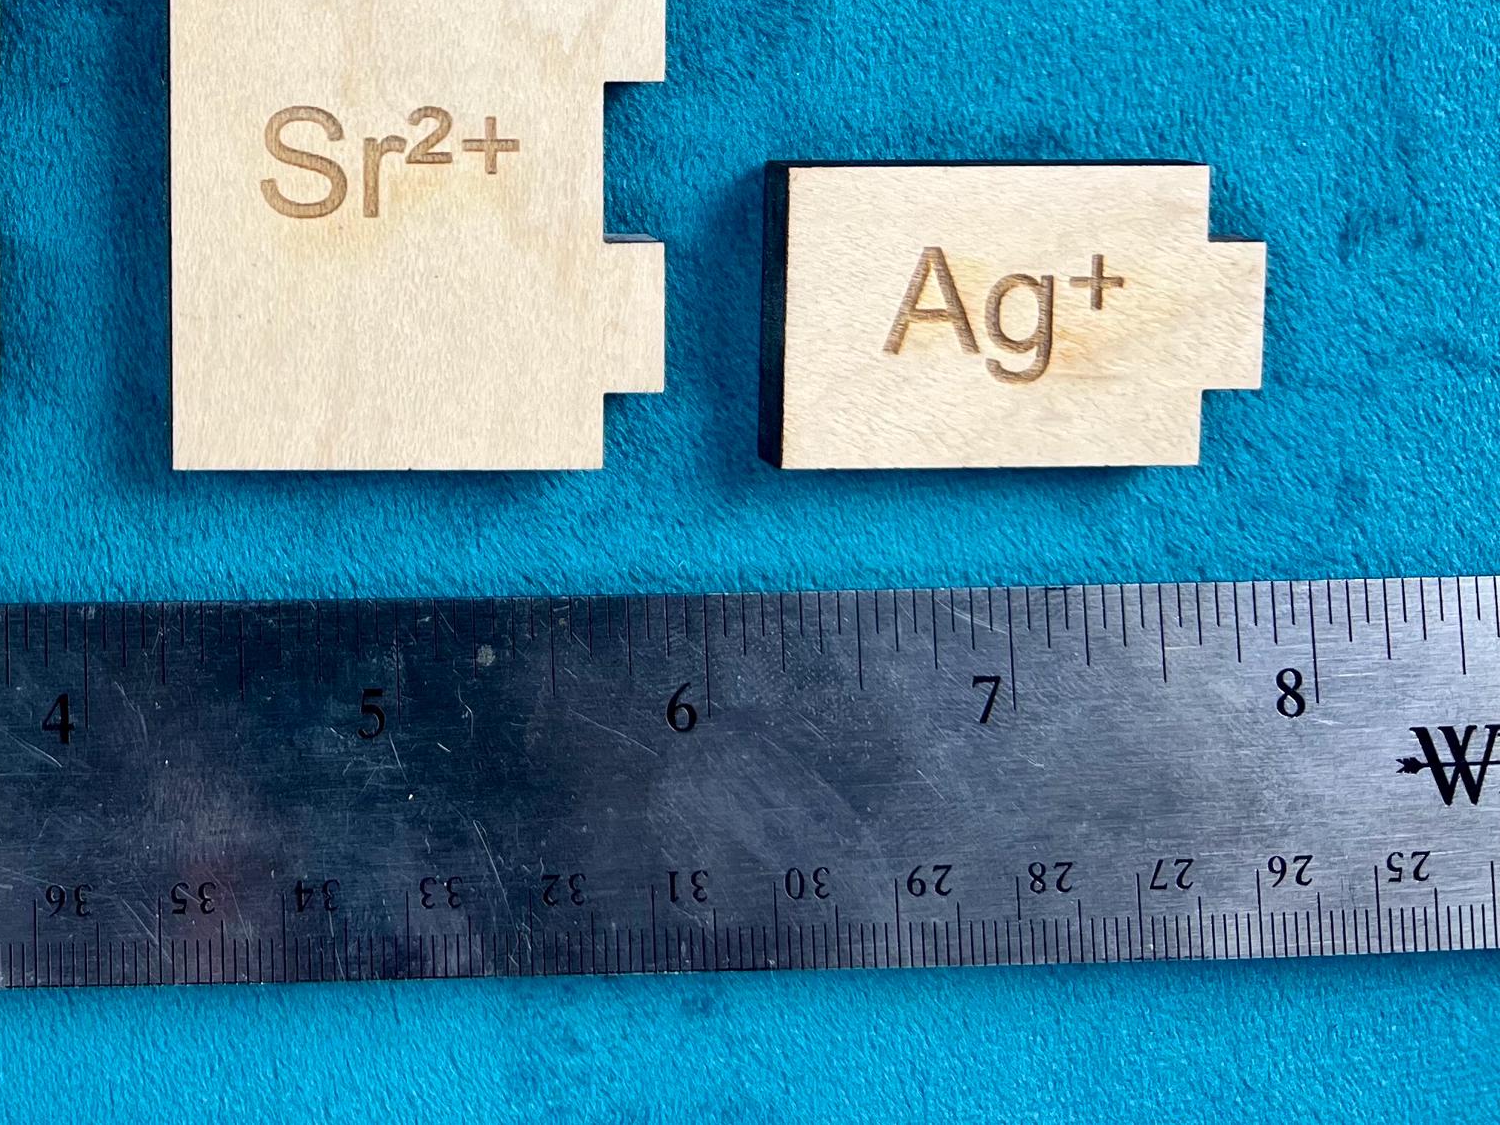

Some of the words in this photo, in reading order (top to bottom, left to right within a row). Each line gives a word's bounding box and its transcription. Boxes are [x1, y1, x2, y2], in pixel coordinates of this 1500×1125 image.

[42, 693, 75, 745] 4
[357, 688, 386, 739] 5
[666, 682, 697, 733] 6
[971, 674, 1002, 725] 7
[1275, 668, 1306, 718] 8
[1408, 724, 1500, 807] W
[784, 866, 831, 901] 30
[906, 864, 953, 898] 29
[1028, 861, 1074, 894] 28
[1148, 858, 1195, 892] 27
[1267, 854, 1314, 887] 26
[1386, 850, 1431, 884] 25
[45, 883, 92, 917] 36
[170, 881, 216, 914] 35
[293, 879, 341, 912] 34
[419, 876, 464, 910] 33
[541, 873, 587, 907] 32
[667, 870, 709, 904] 31
